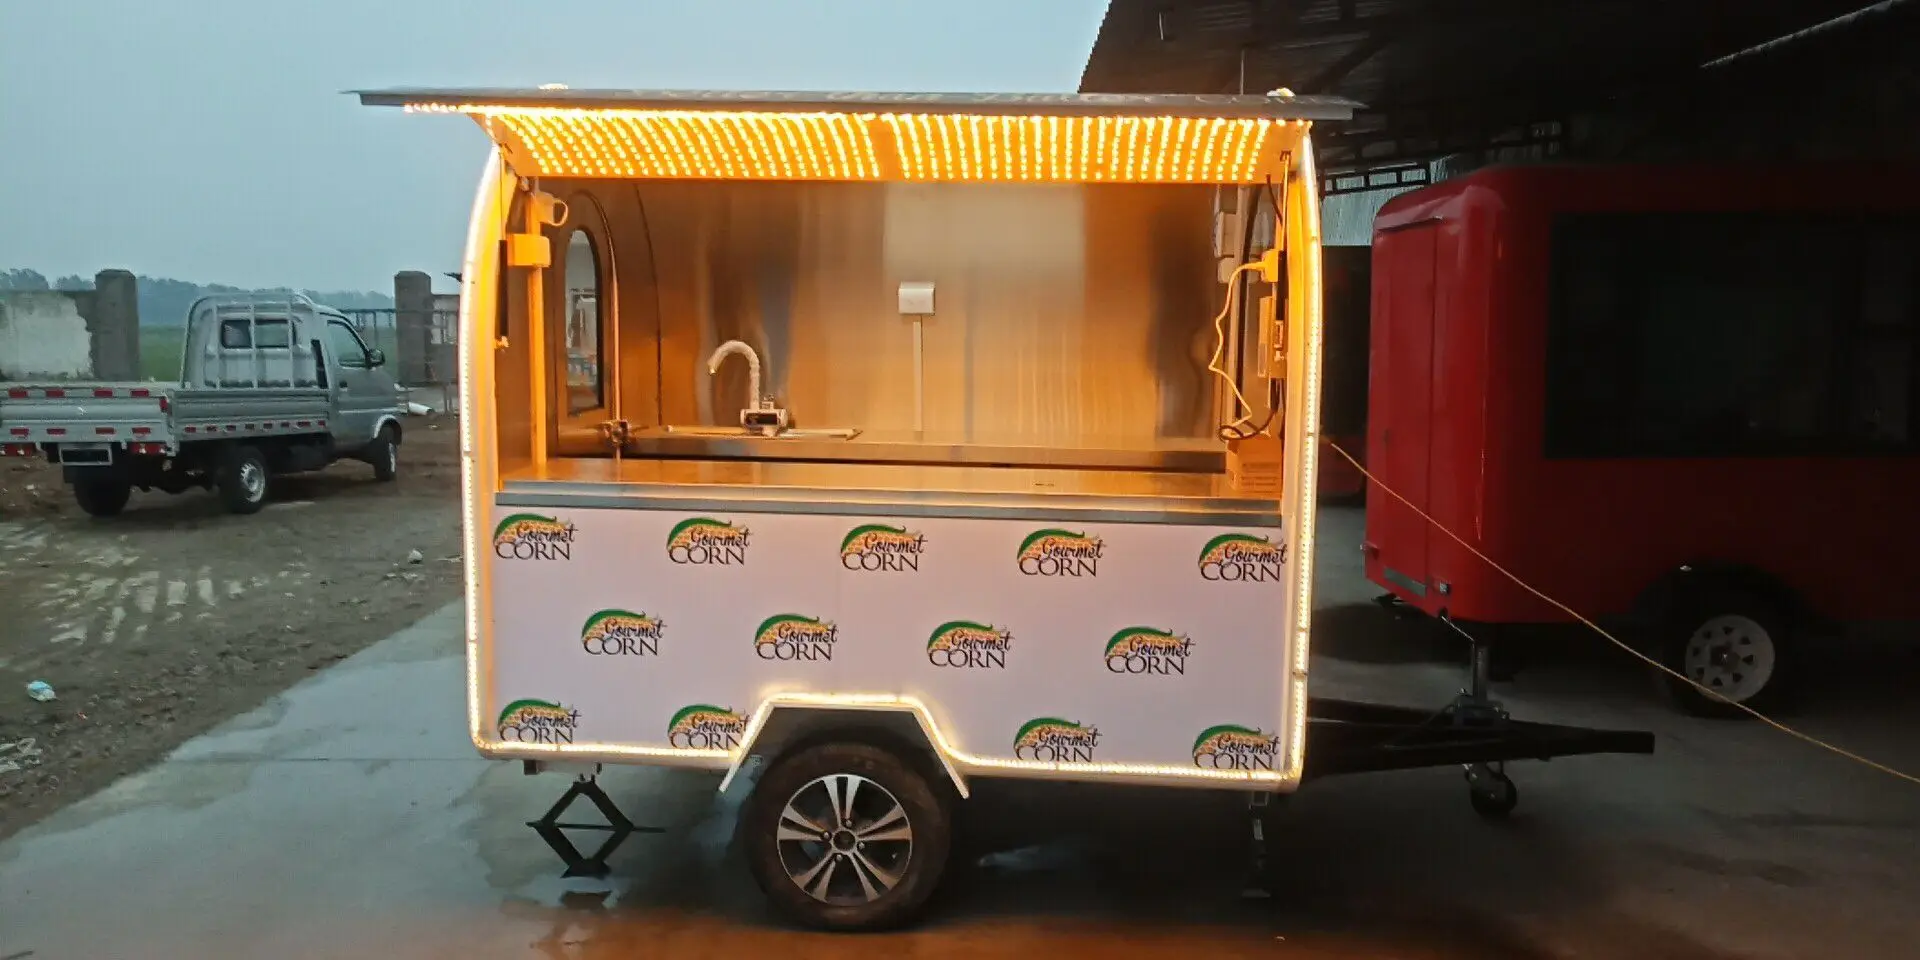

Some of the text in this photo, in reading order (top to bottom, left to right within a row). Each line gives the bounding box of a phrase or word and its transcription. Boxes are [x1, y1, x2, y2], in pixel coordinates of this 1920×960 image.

[516, 520, 578, 545] Gourmet
[690, 525, 753, 549] Gourmet
[496, 540, 570, 561] CORN
[669, 545, 744, 565] CORN
[864, 533, 928, 556] Gourmet
[1042, 536, 1106, 560] Gourmet
[1224, 542, 1287, 565] Gourmet
[842, 552, 918, 572] CORN
[1019, 557, 1096, 577] CORN
[1201, 561, 1280, 582] CORN
[605, 617, 667, 641] Gourmet
[778, 622, 839, 645] Gourmet
[584, 636, 658, 656] CORN
[757, 641, 832, 661] CORN
[951, 630, 1014, 652] Gourmet
[1129, 635, 1194, 658] Gourmet
[930, 648, 1005, 669] CORN
[1106, 654, 1184, 675] CORN
[520, 707, 582, 731] Gourmet
[1038, 725, 1101, 749] Gourmet
[1216, 733, 1280, 757] Gourmet
